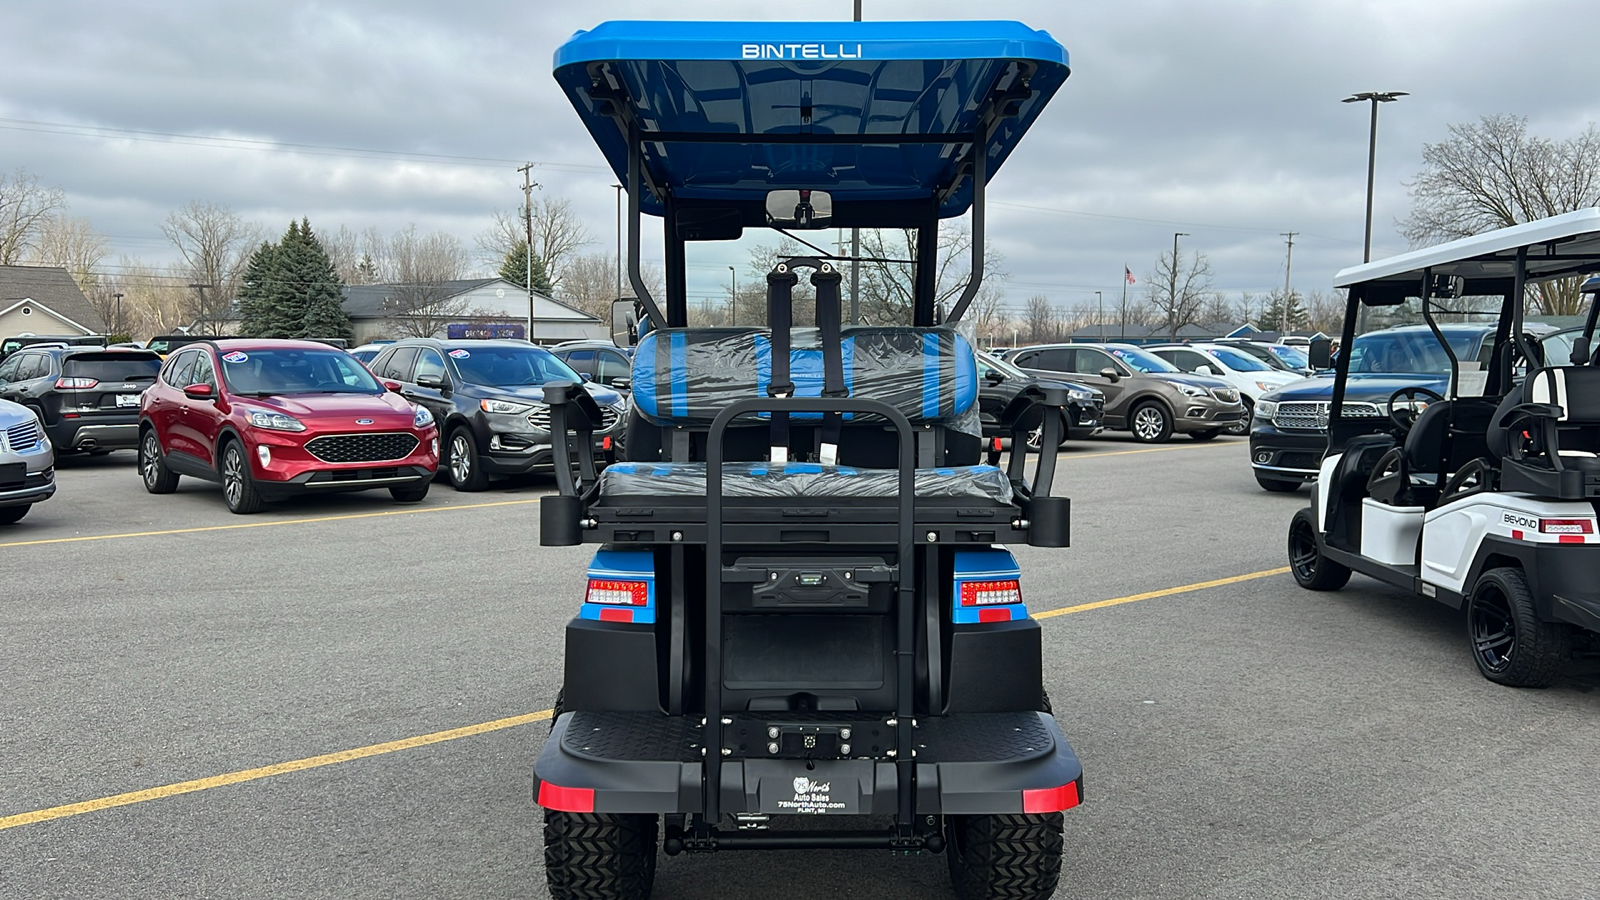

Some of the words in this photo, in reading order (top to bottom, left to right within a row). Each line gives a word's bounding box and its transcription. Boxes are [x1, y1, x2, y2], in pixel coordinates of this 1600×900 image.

[742, 44, 861, 58] BINTELLI
[1504, 514, 1537, 528] BEYOND
[806, 781, 830, 793] North
[794, 793, 810, 801] Auto
[811, 793, 830, 801] Sales
